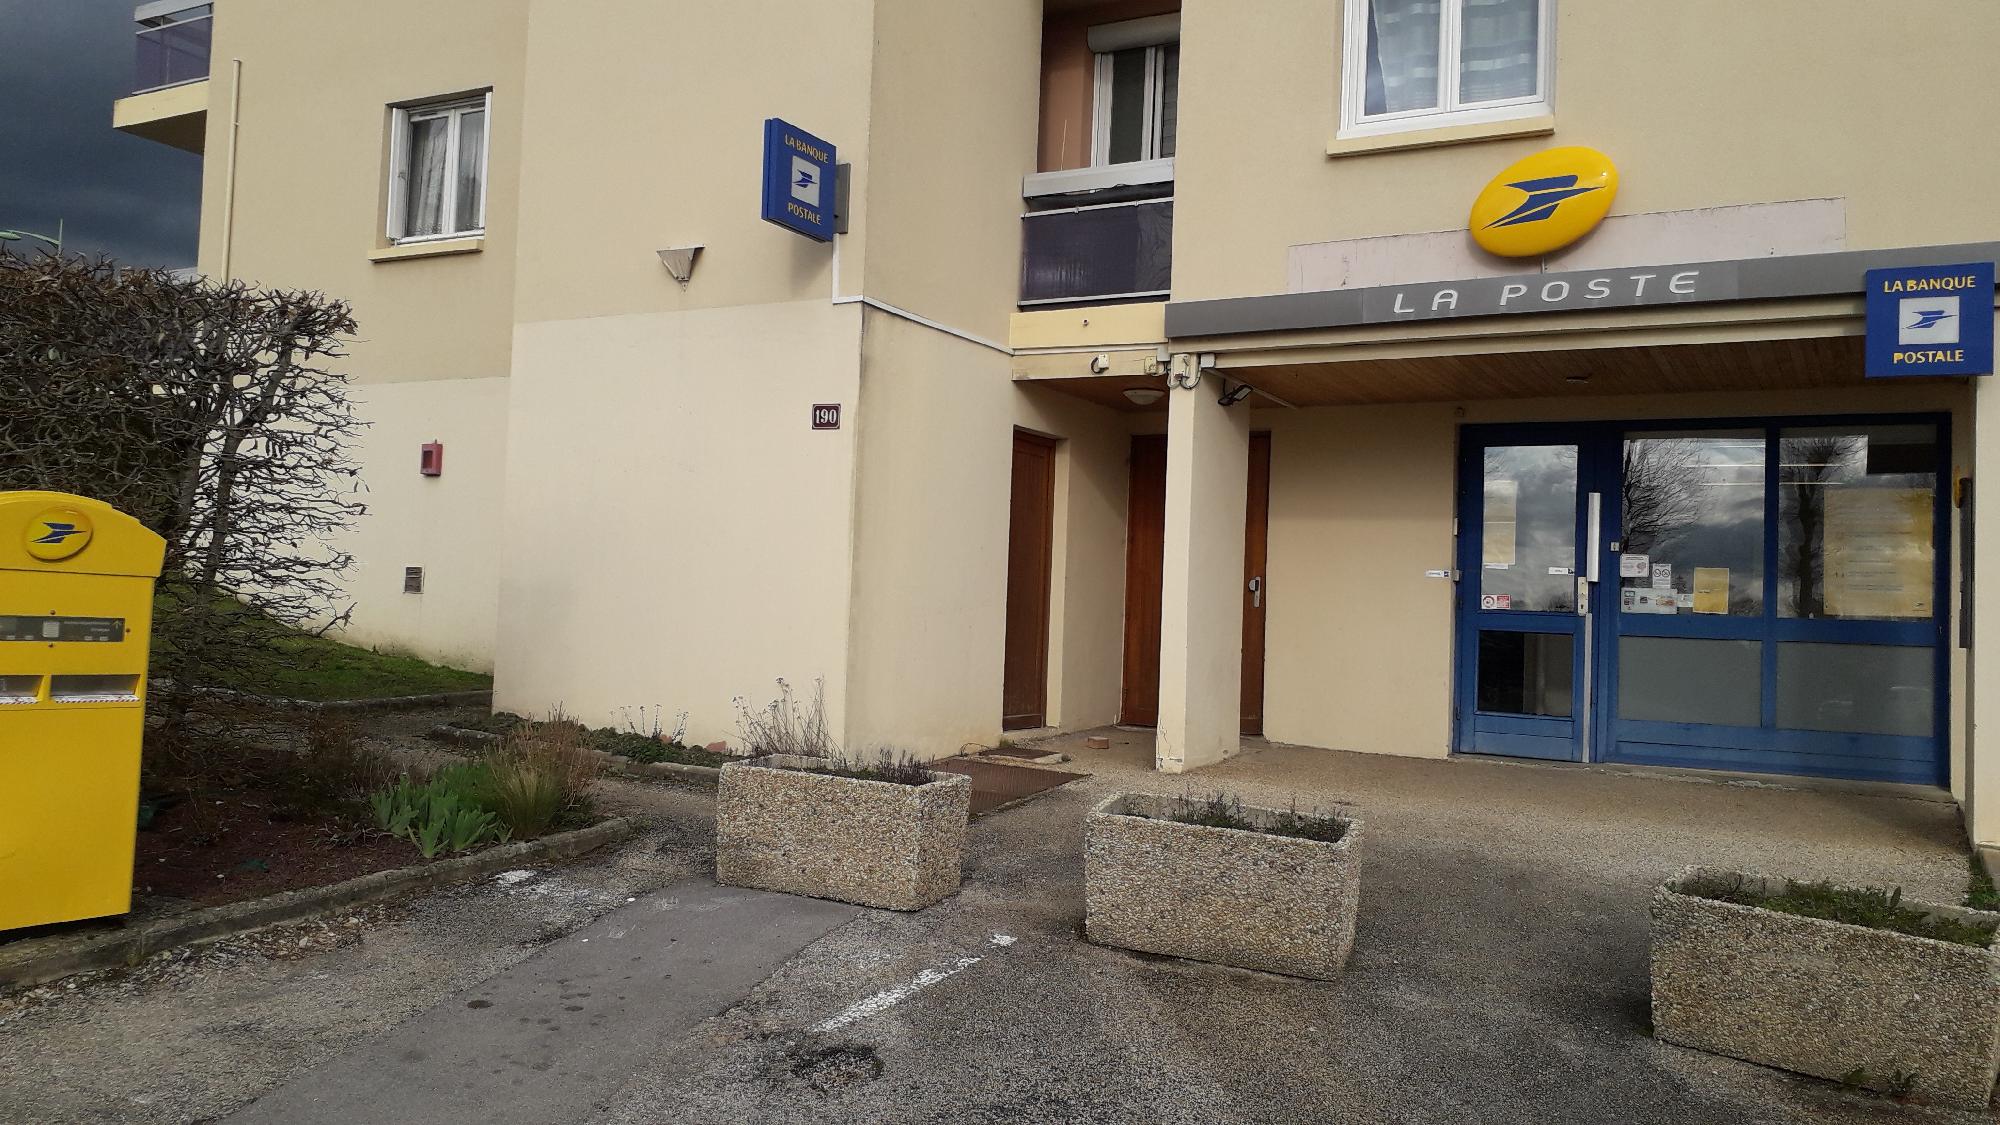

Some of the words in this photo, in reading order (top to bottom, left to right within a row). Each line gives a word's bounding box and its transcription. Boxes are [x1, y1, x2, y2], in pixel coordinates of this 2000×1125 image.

[785, 134, 796, 149] LA
[797, 140, 829, 164] BANQUE
[788, 202, 822, 225] POSTALE
[1393, 289, 1459, 313] LA
[1500, 271, 1700, 306] POSTE
[1884, 280, 1903, 293] LA
[1906, 275, 1976, 292] BANQUE
[1893, 350, 1965, 364] POSTALE
[815, 408, 837, 424] 190
